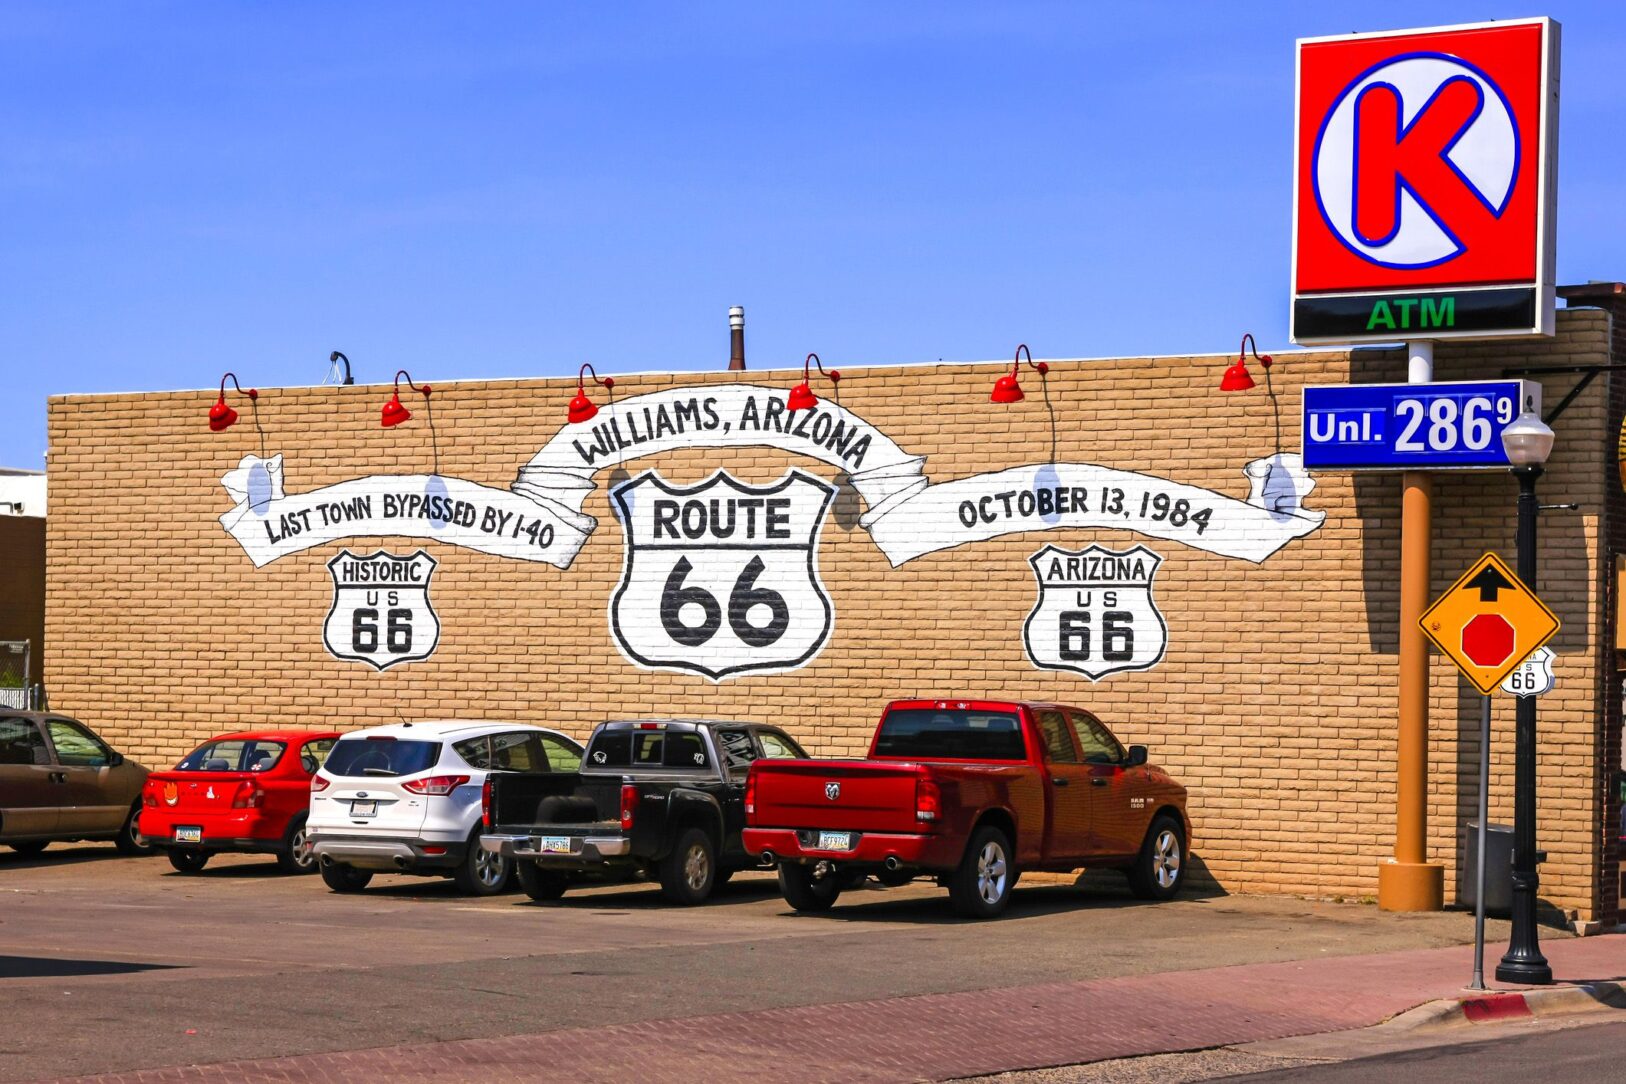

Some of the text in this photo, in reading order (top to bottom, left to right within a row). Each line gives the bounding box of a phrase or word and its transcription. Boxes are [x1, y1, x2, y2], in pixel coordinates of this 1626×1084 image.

[1366, 297, 1455, 330] ATM
[572, 396, 872, 469] WILLIAMS, ARIZONA
[1309, 412, 1382, 442] Unl.
[264, 494, 555, 549] LAST TOWN BYPASSED BY I-40
[653, 498, 791, 539] ROUTE
[958, 486, 1213, 536] OCTOBER 13, 1984
[343, 561, 422, 581] HISTORIC
[1047, 557, 1147, 581] ARIZONA
[660, 555, 790, 648] 66
[352, 608, 413, 653] 66
[1059, 610, 1134, 661] 66
[1512, 672, 1535, 689] 66
